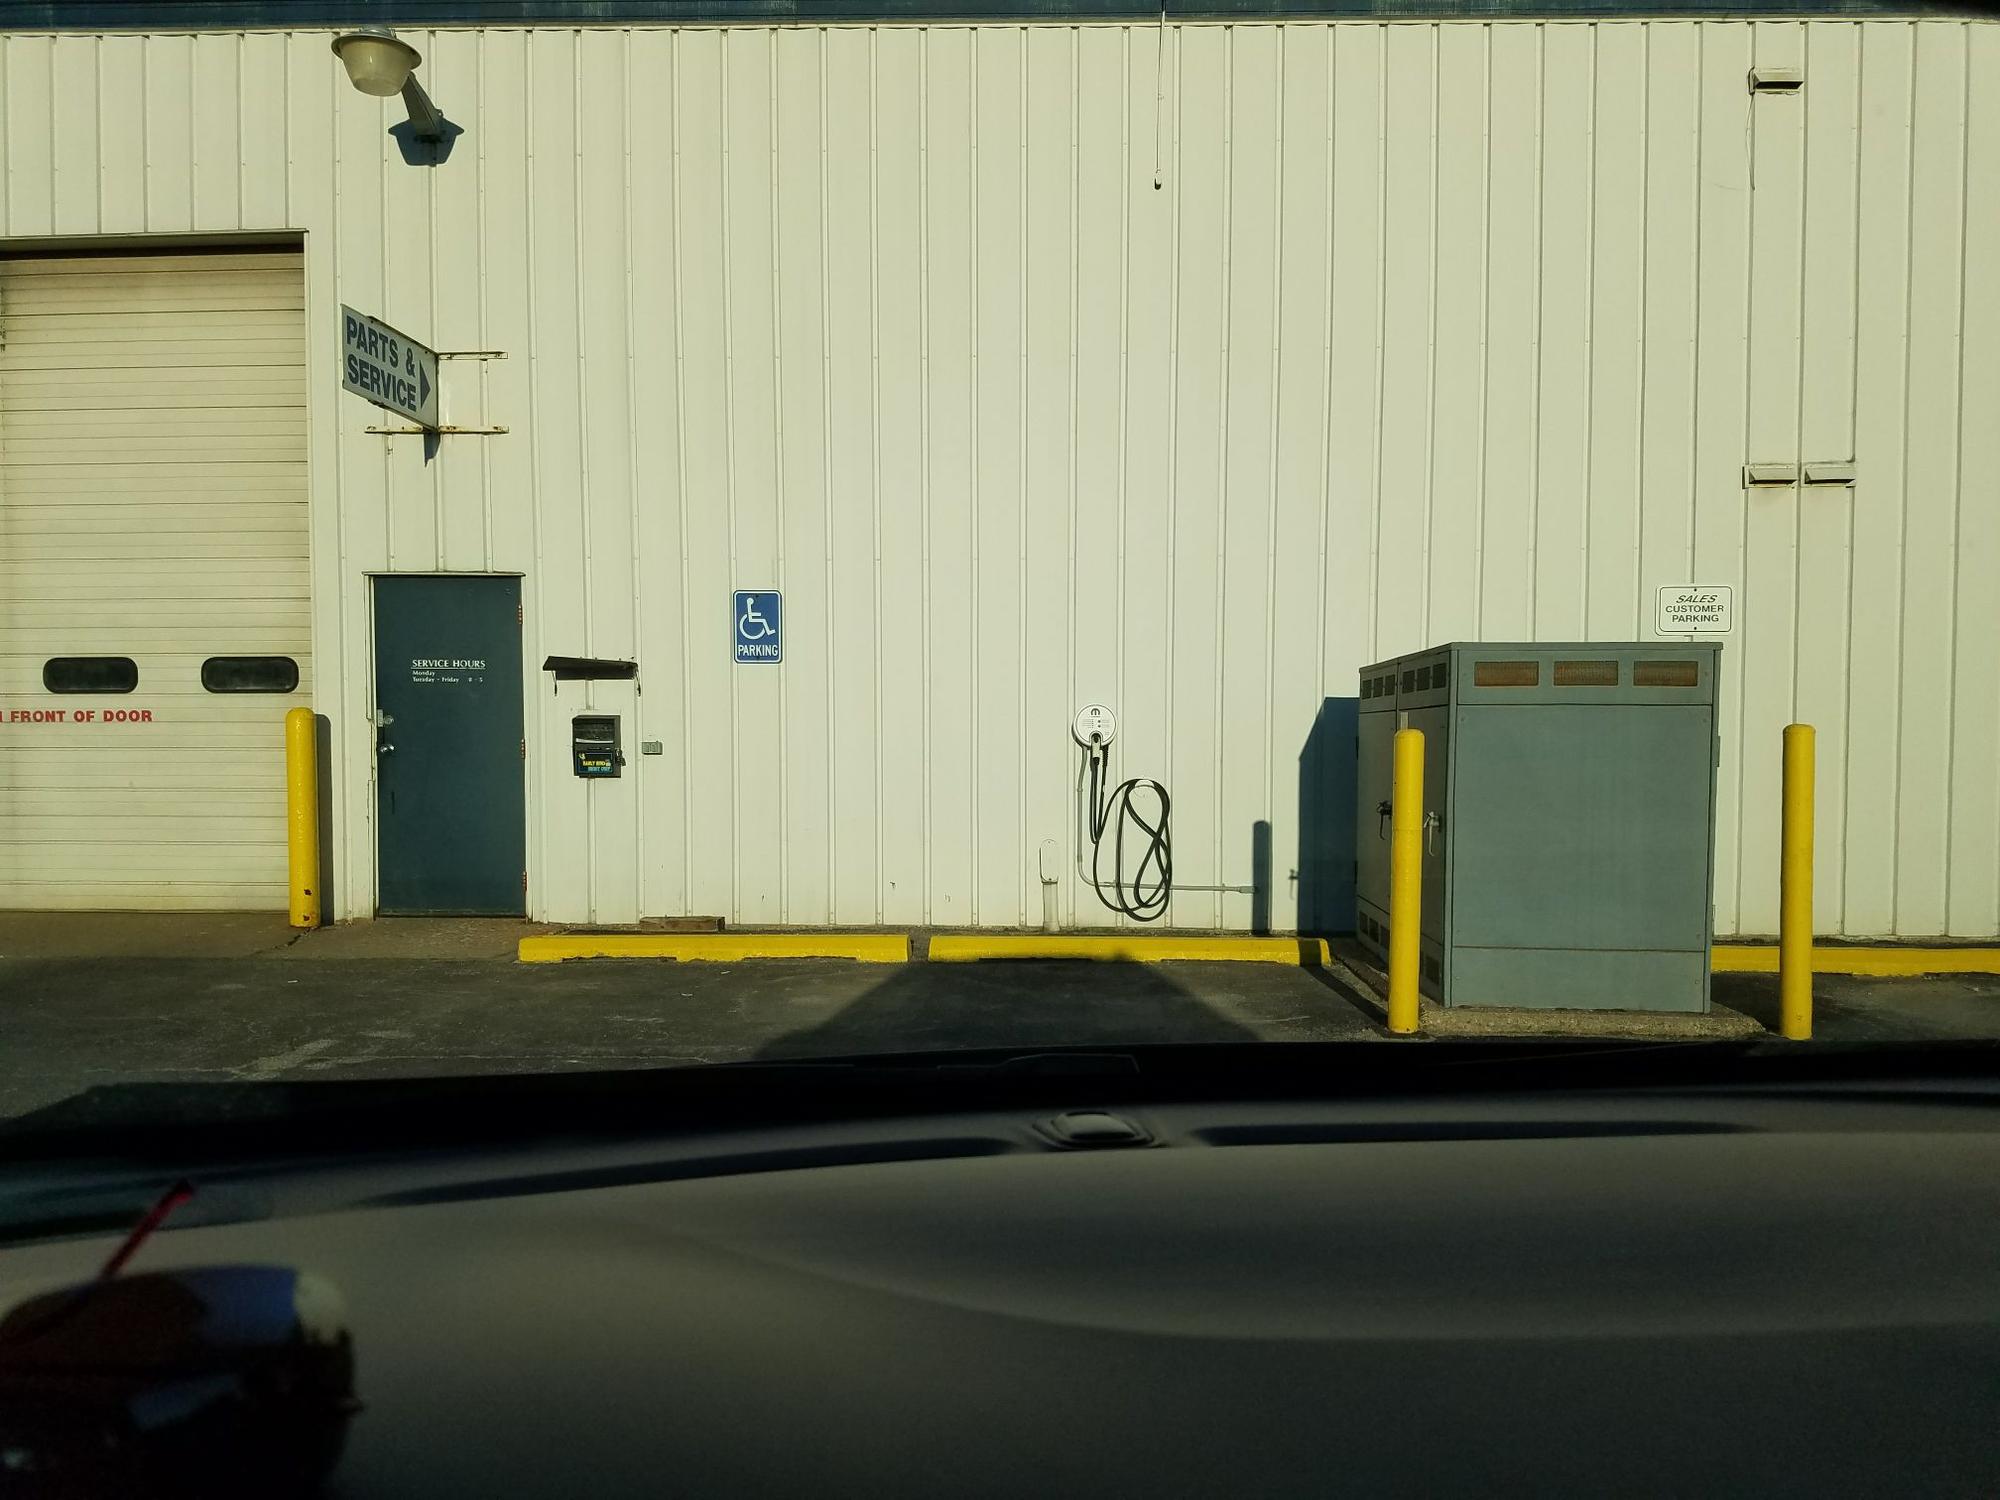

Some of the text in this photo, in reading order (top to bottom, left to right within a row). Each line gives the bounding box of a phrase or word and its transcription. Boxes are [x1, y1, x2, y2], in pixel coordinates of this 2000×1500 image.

[346, 315, 416, 378] PARTS &
[347, 353, 417, 412] SERVICE
[1676, 594, 1718, 603] SALES
[1665, 604, 1724, 613] CUSTOMER
[1672, 614, 1719, 623] PARKING
[738, 644, 778, 656] PARKING
[412, 659, 486, 668] SERVICE HOURS
[10, 710, 66, 722] FRONT
[73, 710, 96, 722] OF
[103, 710, 152, 722] DOOR
